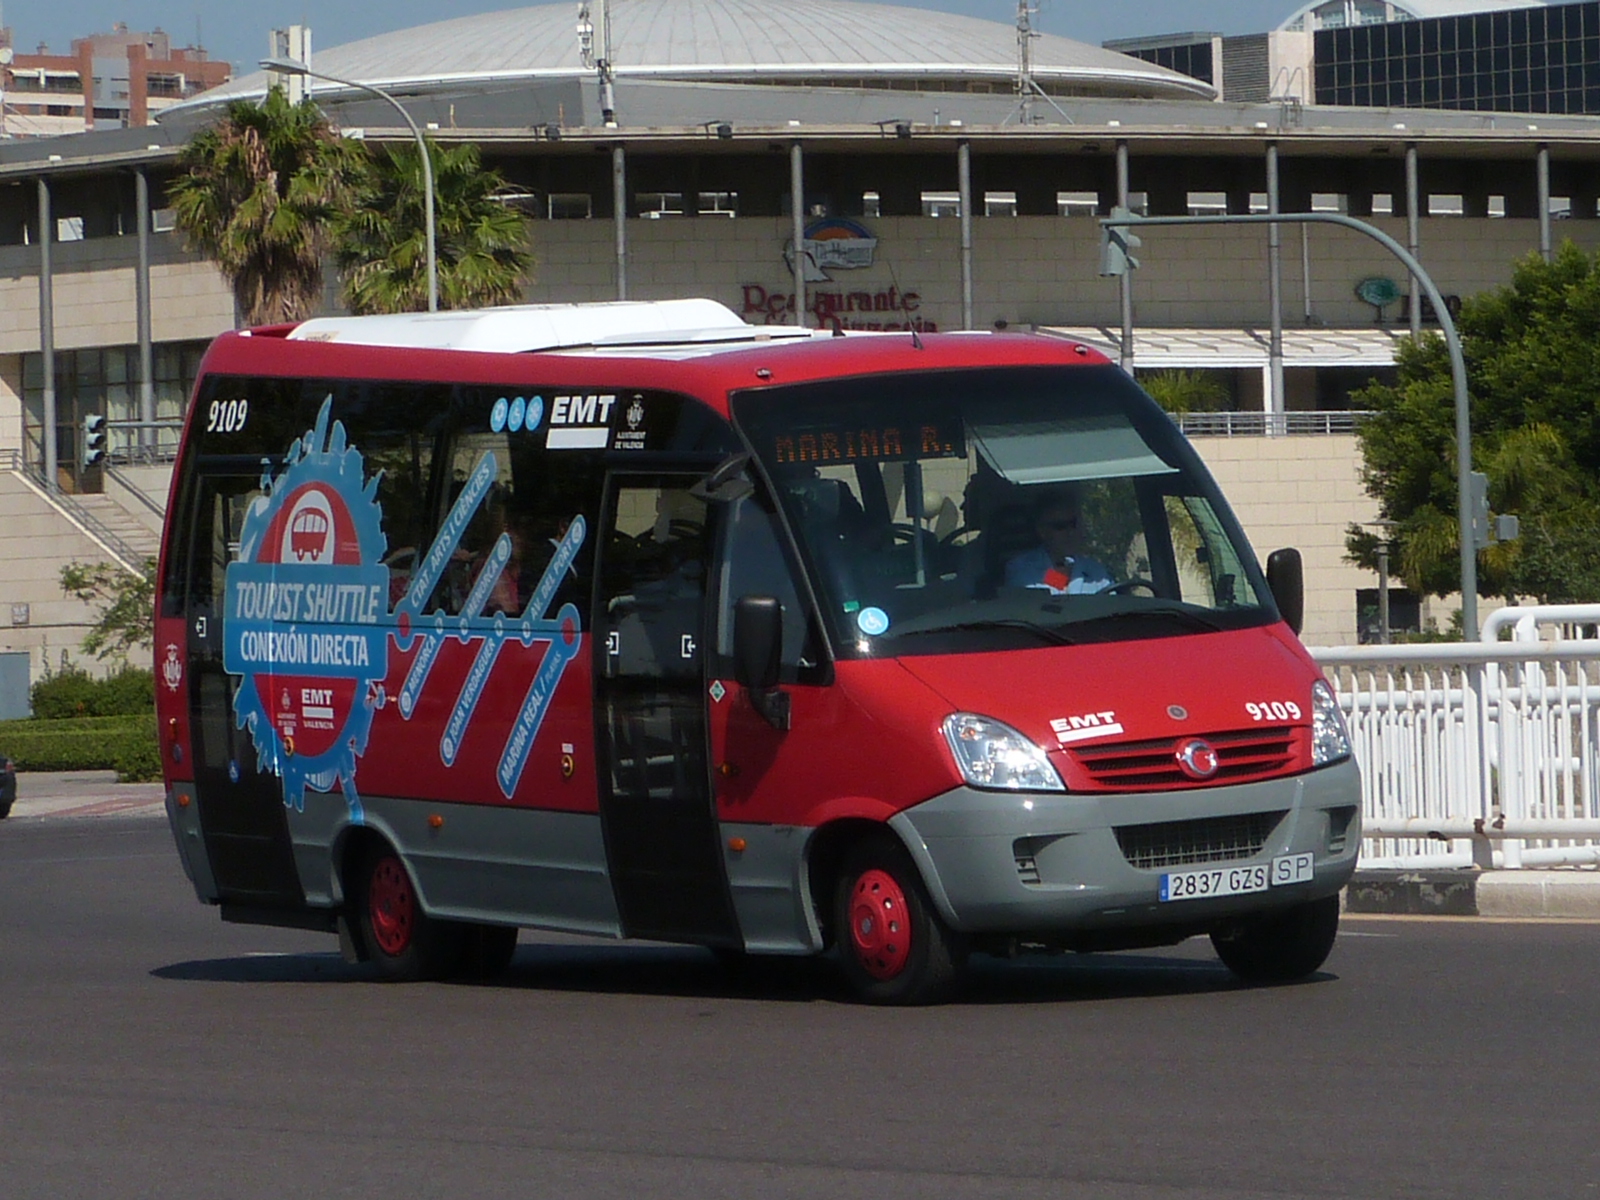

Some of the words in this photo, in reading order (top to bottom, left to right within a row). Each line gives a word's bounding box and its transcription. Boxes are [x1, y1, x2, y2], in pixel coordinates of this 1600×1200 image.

[207, 399, 248, 432] 9109
[550, 395, 616, 424] EMT
[775, 428, 902, 463] MARINA
[430, 534, 451, 572] ARTS
[541, 574, 556, 599] DEL
[554, 538, 573, 574] PORT
[236, 582, 303, 622] TOURIST
[304, 583, 380, 624] SHUTTLE
[466, 559, 499, 620] MENORCA
[240, 625, 307, 664] CONEXIÓN
[311, 634, 369, 667] DIRECTA
[407, 634, 437, 694] MENORCA
[301, 688, 333, 705] EMT
[451, 709, 465, 744] JOAN
[463, 638, 496, 710] VERDAGUER
[1049, 711, 1115, 733] EMT
[1246, 701, 1301, 721] 9109
[501, 725, 529, 785] MARINA
[523, 692, 544, 728] REAL
[1172, 872, 1223, 897] 2837
[1229, 868, 1265, 891] GZS
